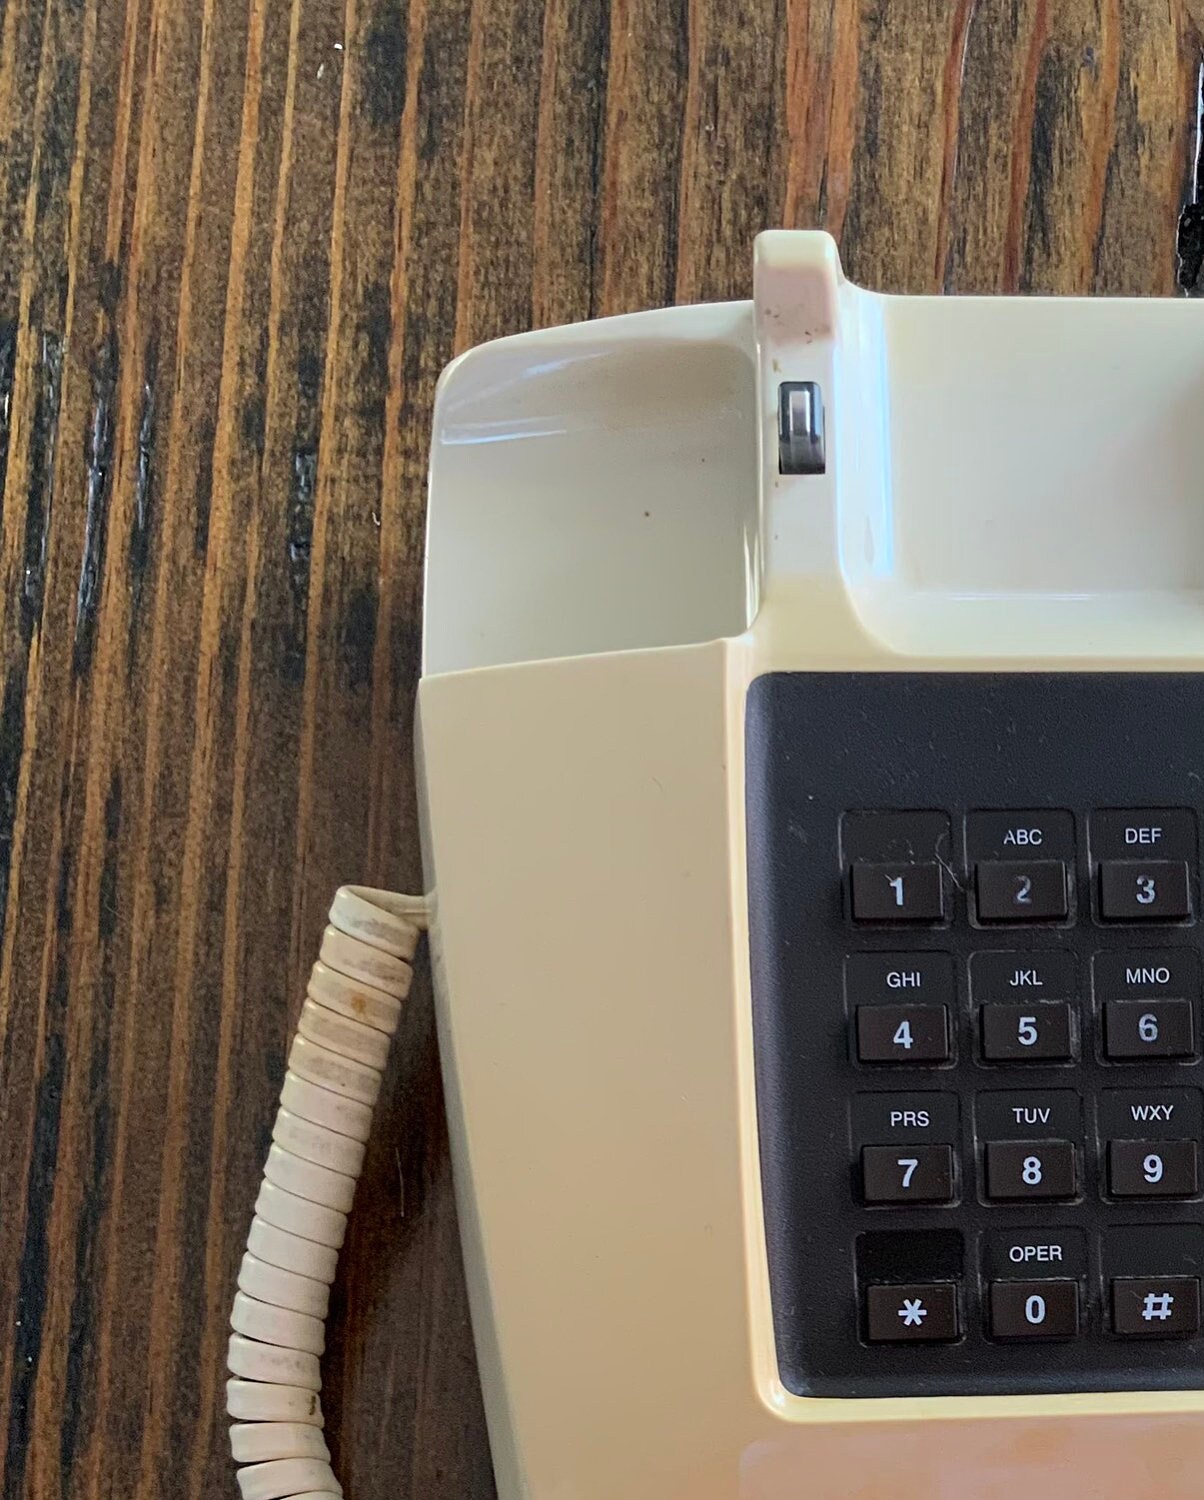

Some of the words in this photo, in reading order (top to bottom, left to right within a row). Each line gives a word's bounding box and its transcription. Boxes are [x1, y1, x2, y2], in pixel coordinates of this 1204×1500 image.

[1003, 828, 1042, 845] ABC
[1125, 827, 1162, 844] DEF
[889, 876, 904, 905] 1
[1015, 875, 1032, 904] 2
[1136, 877, 1156, 904] 3
[886, 971, 921, 988] GHI
[1009, 970, 1043, 986] JKL
[1126, 967, 1170, 984] MNO
[892, 1020, 915, 1050] 4
[1018, 1016, 1038, 1046] 5
[1138, 1014, 1158, 1042] 6
[890, 1110, 930, 1127] PRS
[1012, 1107, 1051, 1124] TUV
[1131, 1104, 1174, 1121] WXY
[897, 1158, 918, 1188] 7
[1022, 1156, 1042, 1185] 8
[1143, 1154, 1163, 1183] 9
[1009, 1245, 1063, 1263] OPER
[1025, 1295, 1046, 1324] 0
[1141, 1292, 1174, 1321] #
